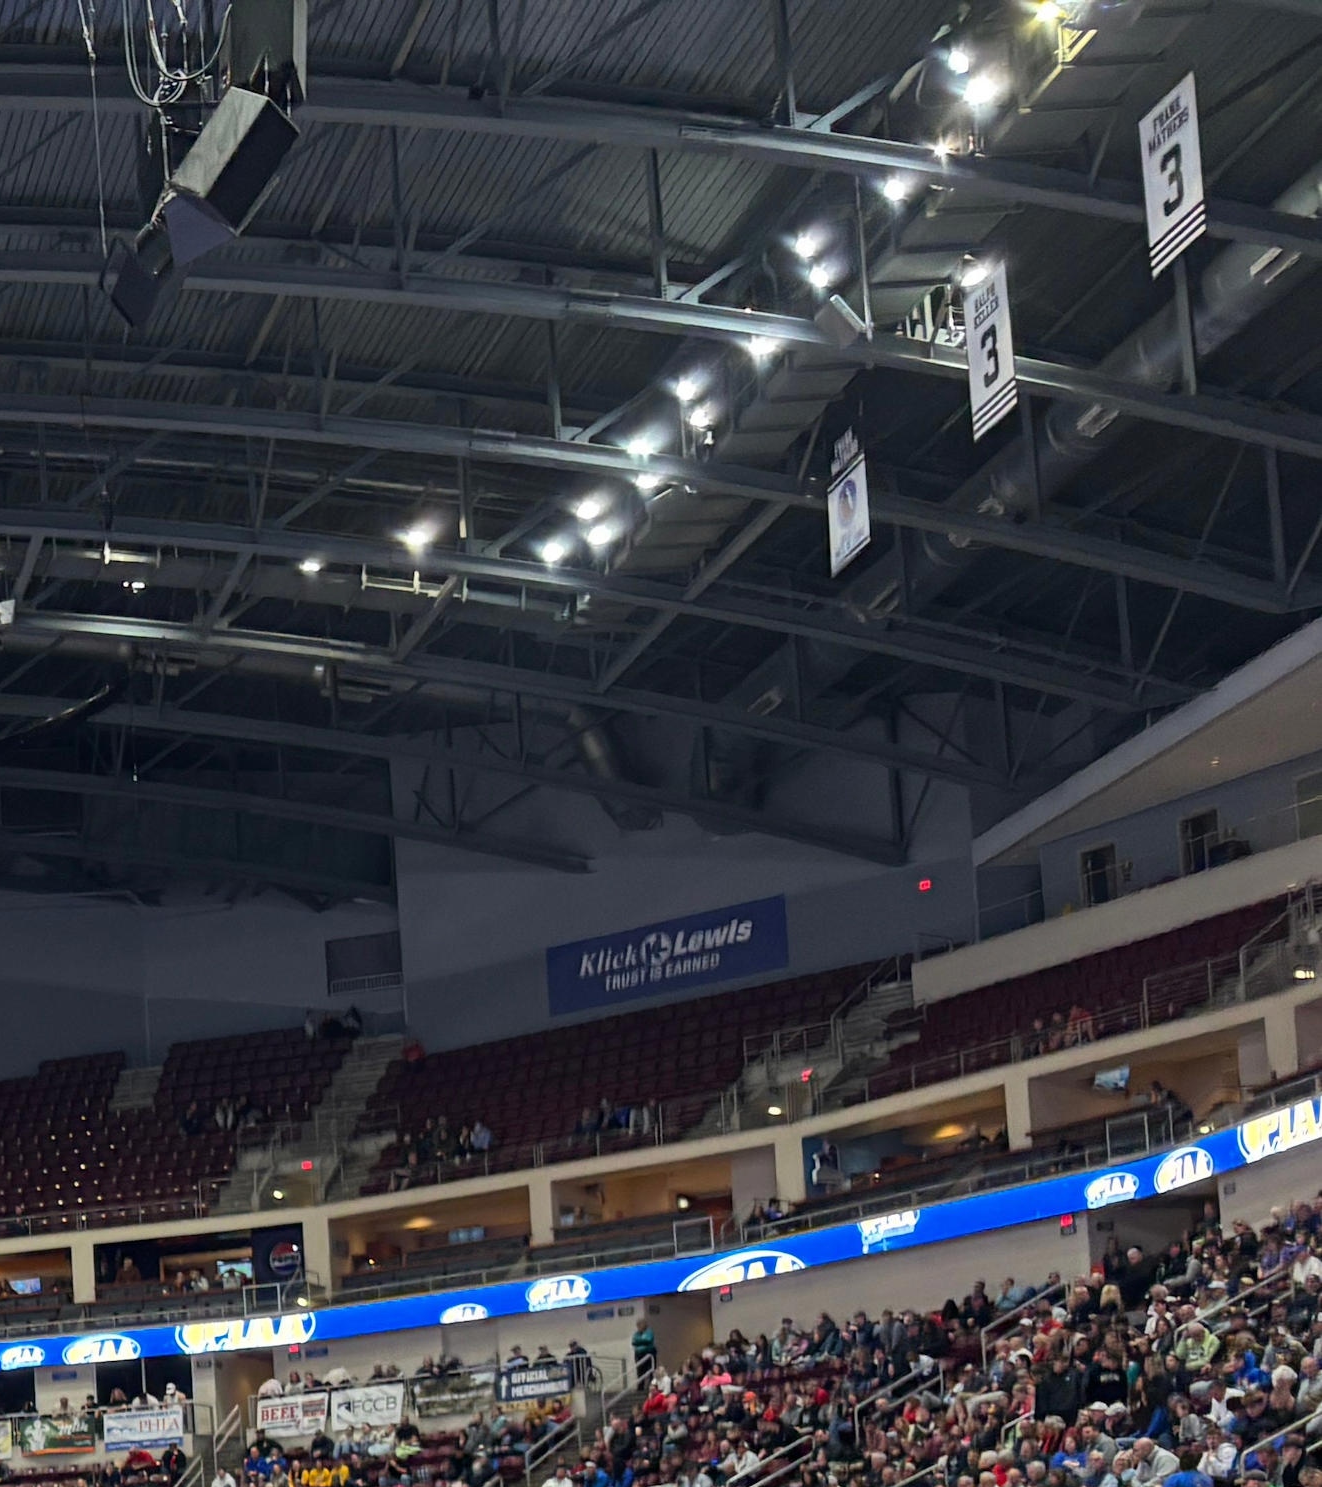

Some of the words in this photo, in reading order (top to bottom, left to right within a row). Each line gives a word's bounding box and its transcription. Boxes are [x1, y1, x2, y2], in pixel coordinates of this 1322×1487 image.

[1161, 144, 1185, 217] 3
[980, 324, 1000, 389] 3
[579, 943, 637, 979] Klick
[674, 918, 753, 956] Lewis
[606, 967, 646, 992] TRUST
[666, 953, 720, 978] EARNED
[178, 1314, 313, 1352] PIAA
[261, 1406, 299, 1423] BEEF
[351, 1397, 398, 1414] FCCB
